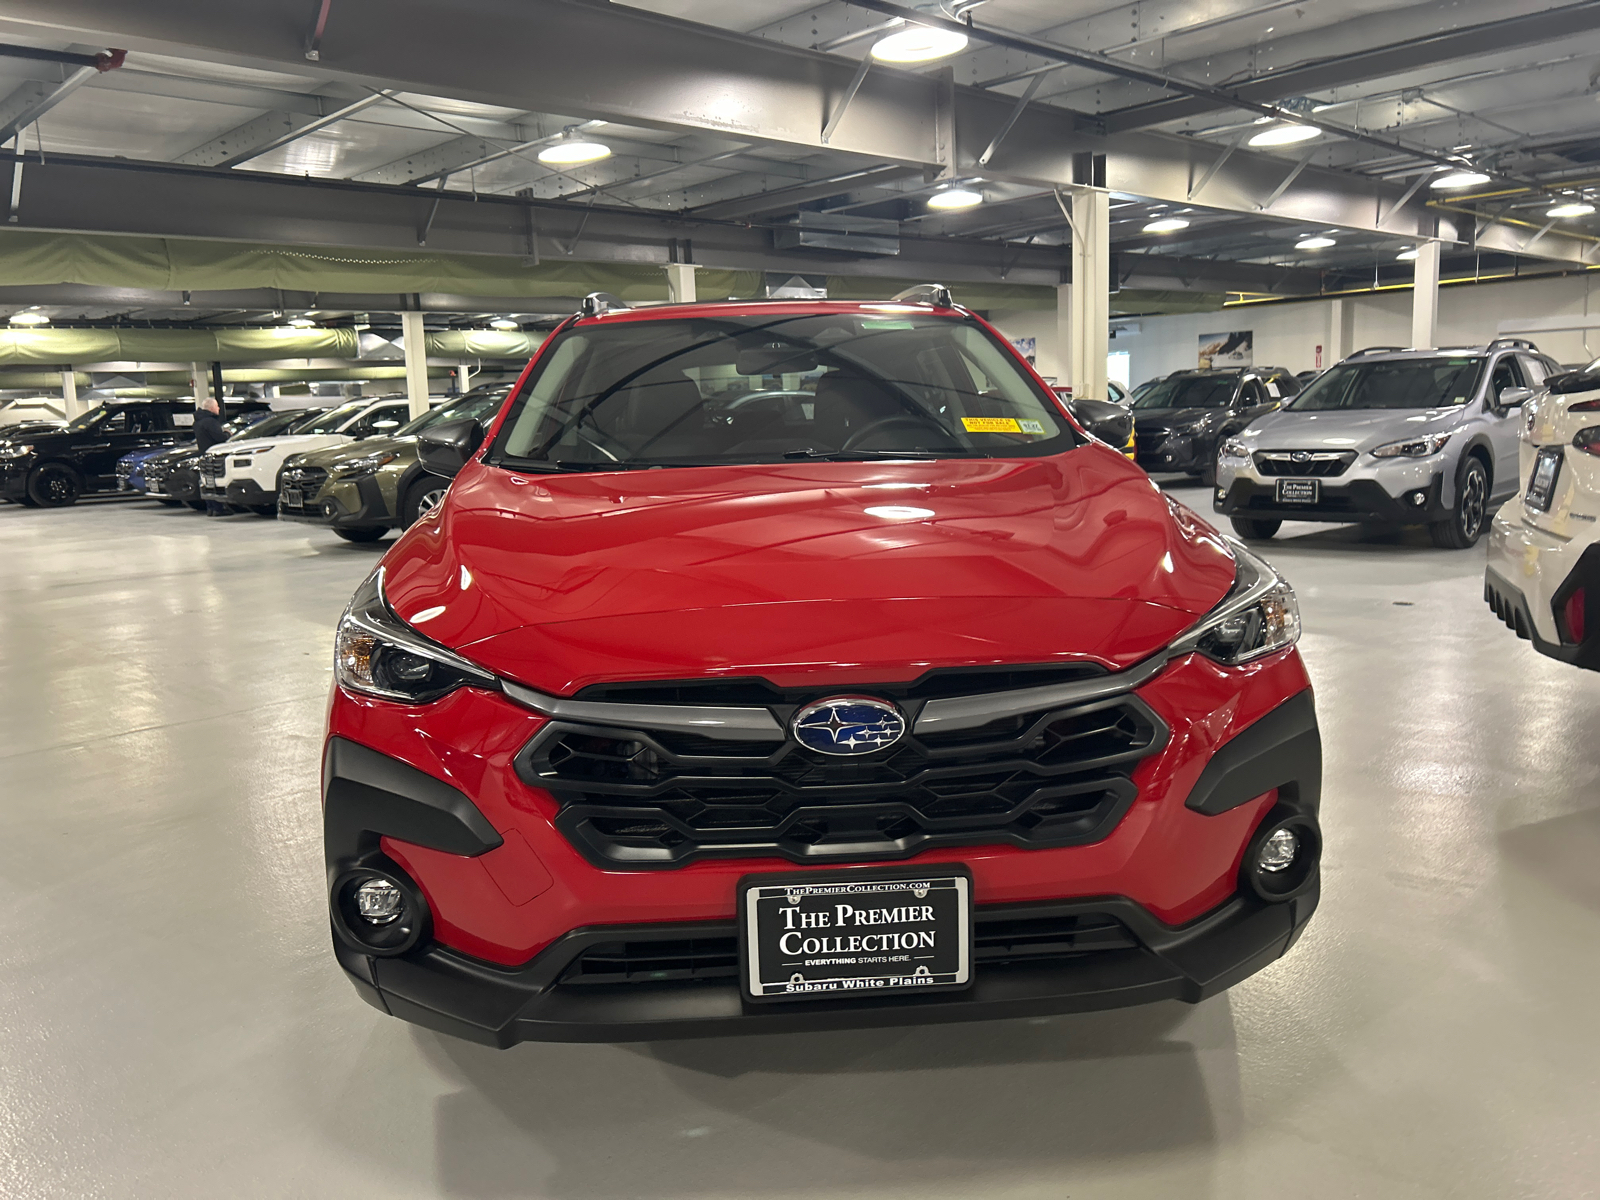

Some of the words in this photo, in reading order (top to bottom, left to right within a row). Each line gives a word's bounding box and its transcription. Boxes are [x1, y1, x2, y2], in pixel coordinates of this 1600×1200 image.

[778, 905, 831, 930] THE
[834, 904, 936, 927] PREMIER
[779, 930, 936, 956] COLLECTION
[804, 956, 857, 967] EVERYTHING
[857, 955, 888, 964] STARTS
[888, 954, 912, 963] HERE.
[785, 980, 837, 993] Subaru
[842, 978, 885, 989] White
[889, 975, 934, 986] Plains
